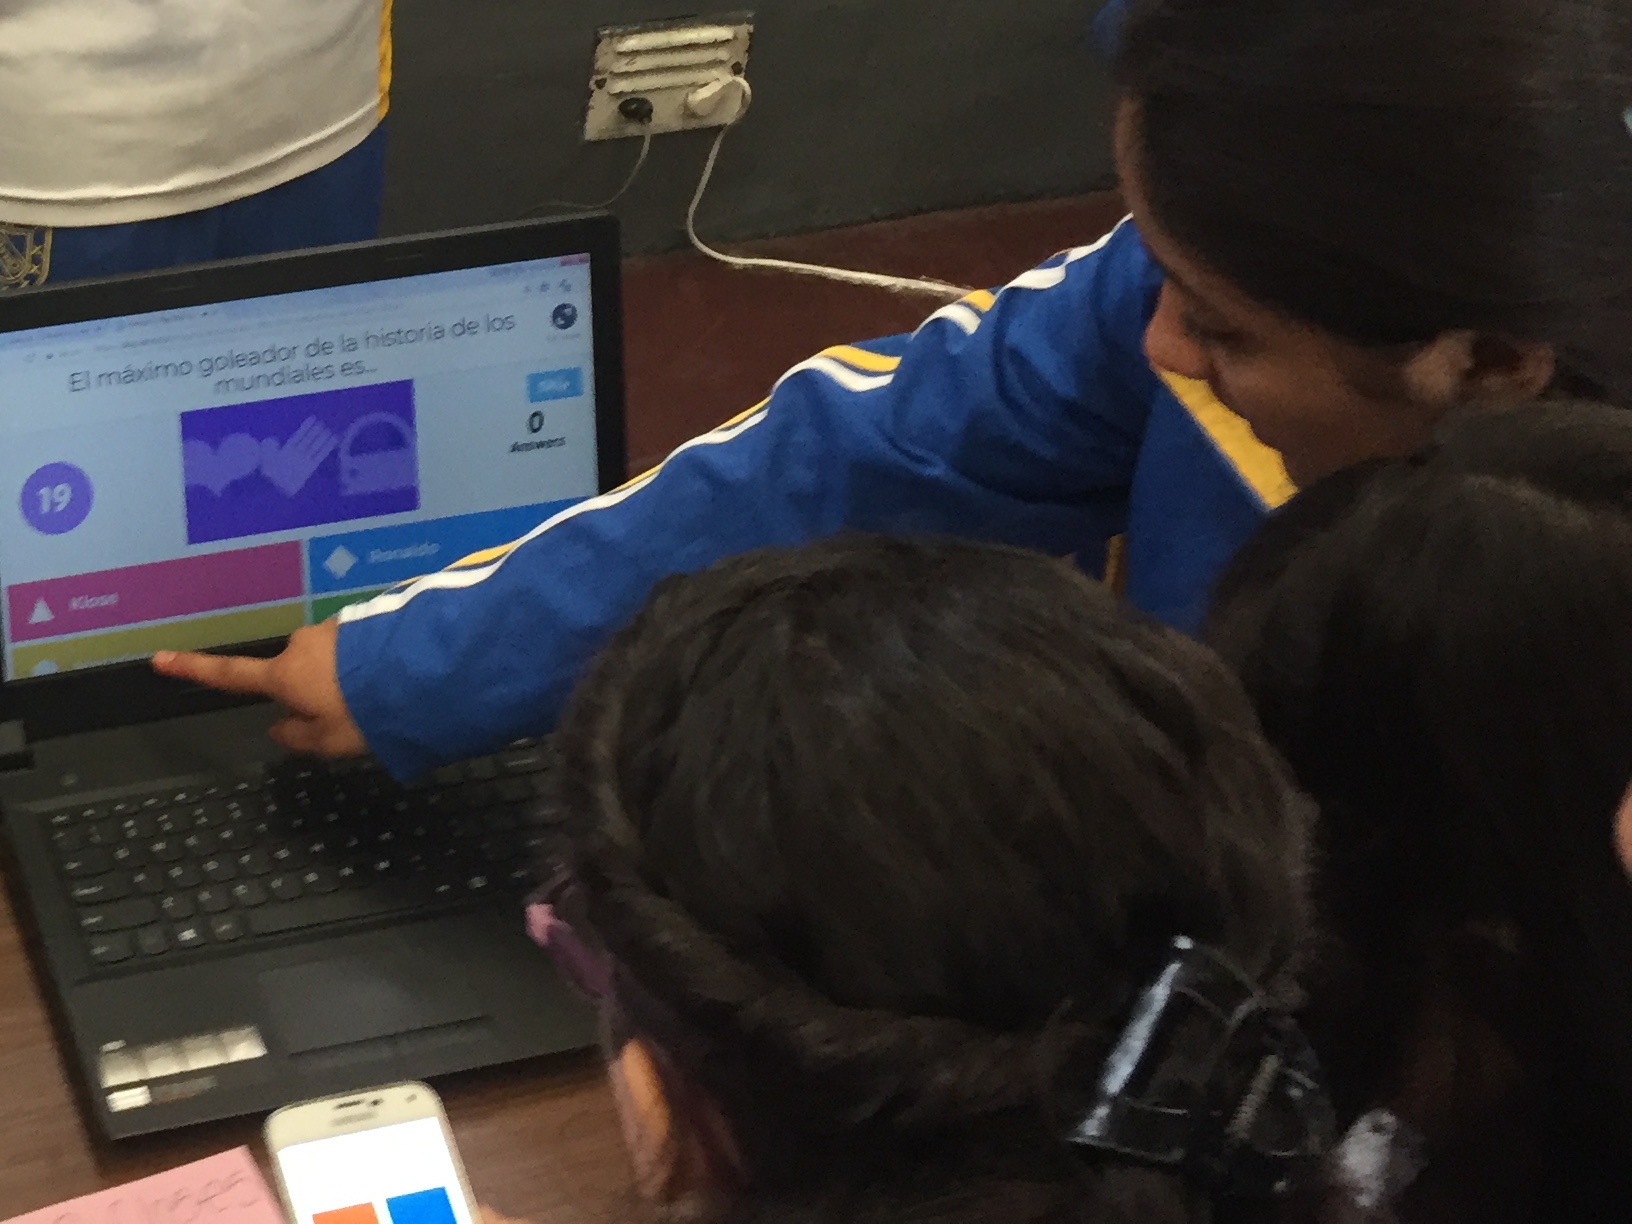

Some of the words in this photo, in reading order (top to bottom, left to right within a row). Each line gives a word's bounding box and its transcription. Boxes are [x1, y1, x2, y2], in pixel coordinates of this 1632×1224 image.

[69, 371, 92, 393] El
[97, 359, 193, 389] máximo
[198, 342, 300, 378] goleador
[303, 337, 335, 358] de
[339, 333, 359, 354] la
[365, 321, 445, 350] historia
[451, 318, 480, 337] de
[485, 313, 517, 333] los
[214, 361, 335, 394] mundiales
[528, 410, 545, 433] 0
[36, 482, 73, 514] 19
